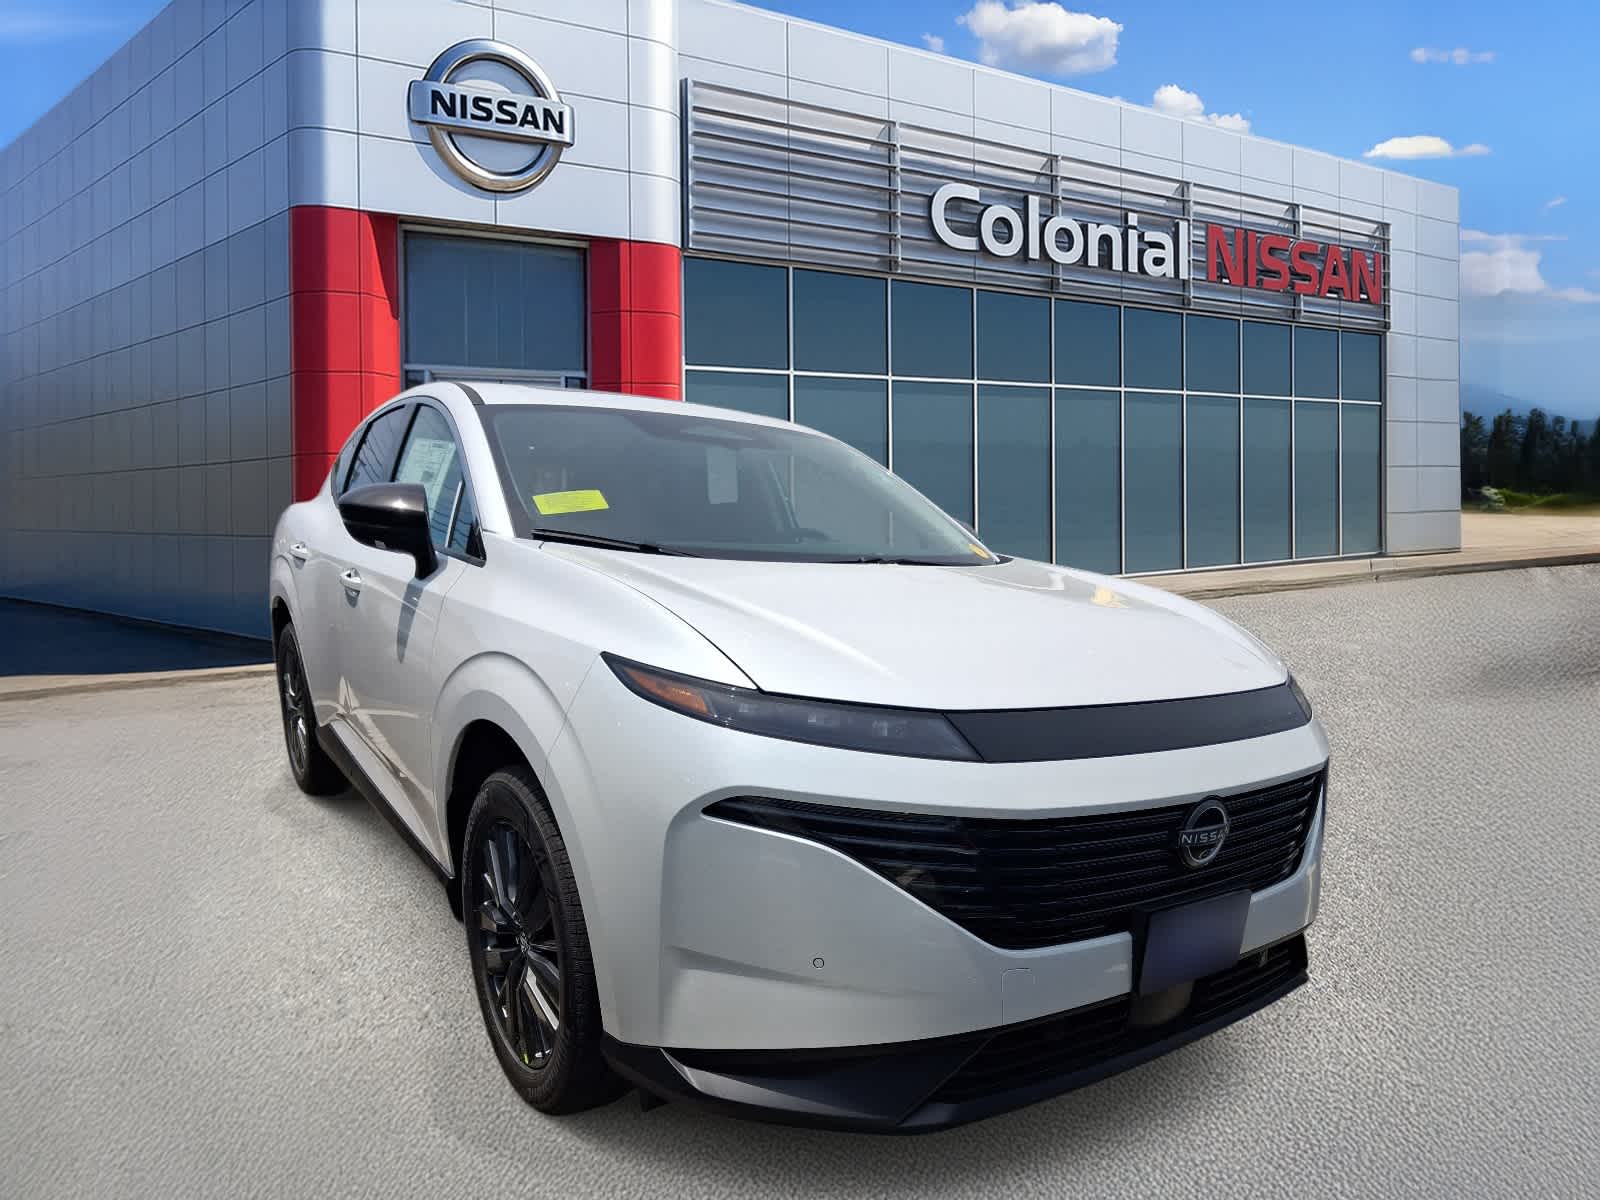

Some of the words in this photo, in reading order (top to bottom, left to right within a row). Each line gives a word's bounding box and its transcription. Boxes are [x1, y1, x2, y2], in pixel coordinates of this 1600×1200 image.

[430, 89, 565, 134] NISSAN
[931, 182, 1188, 280] Colonial
[1207, 223, 1381, 305] NISSAN
